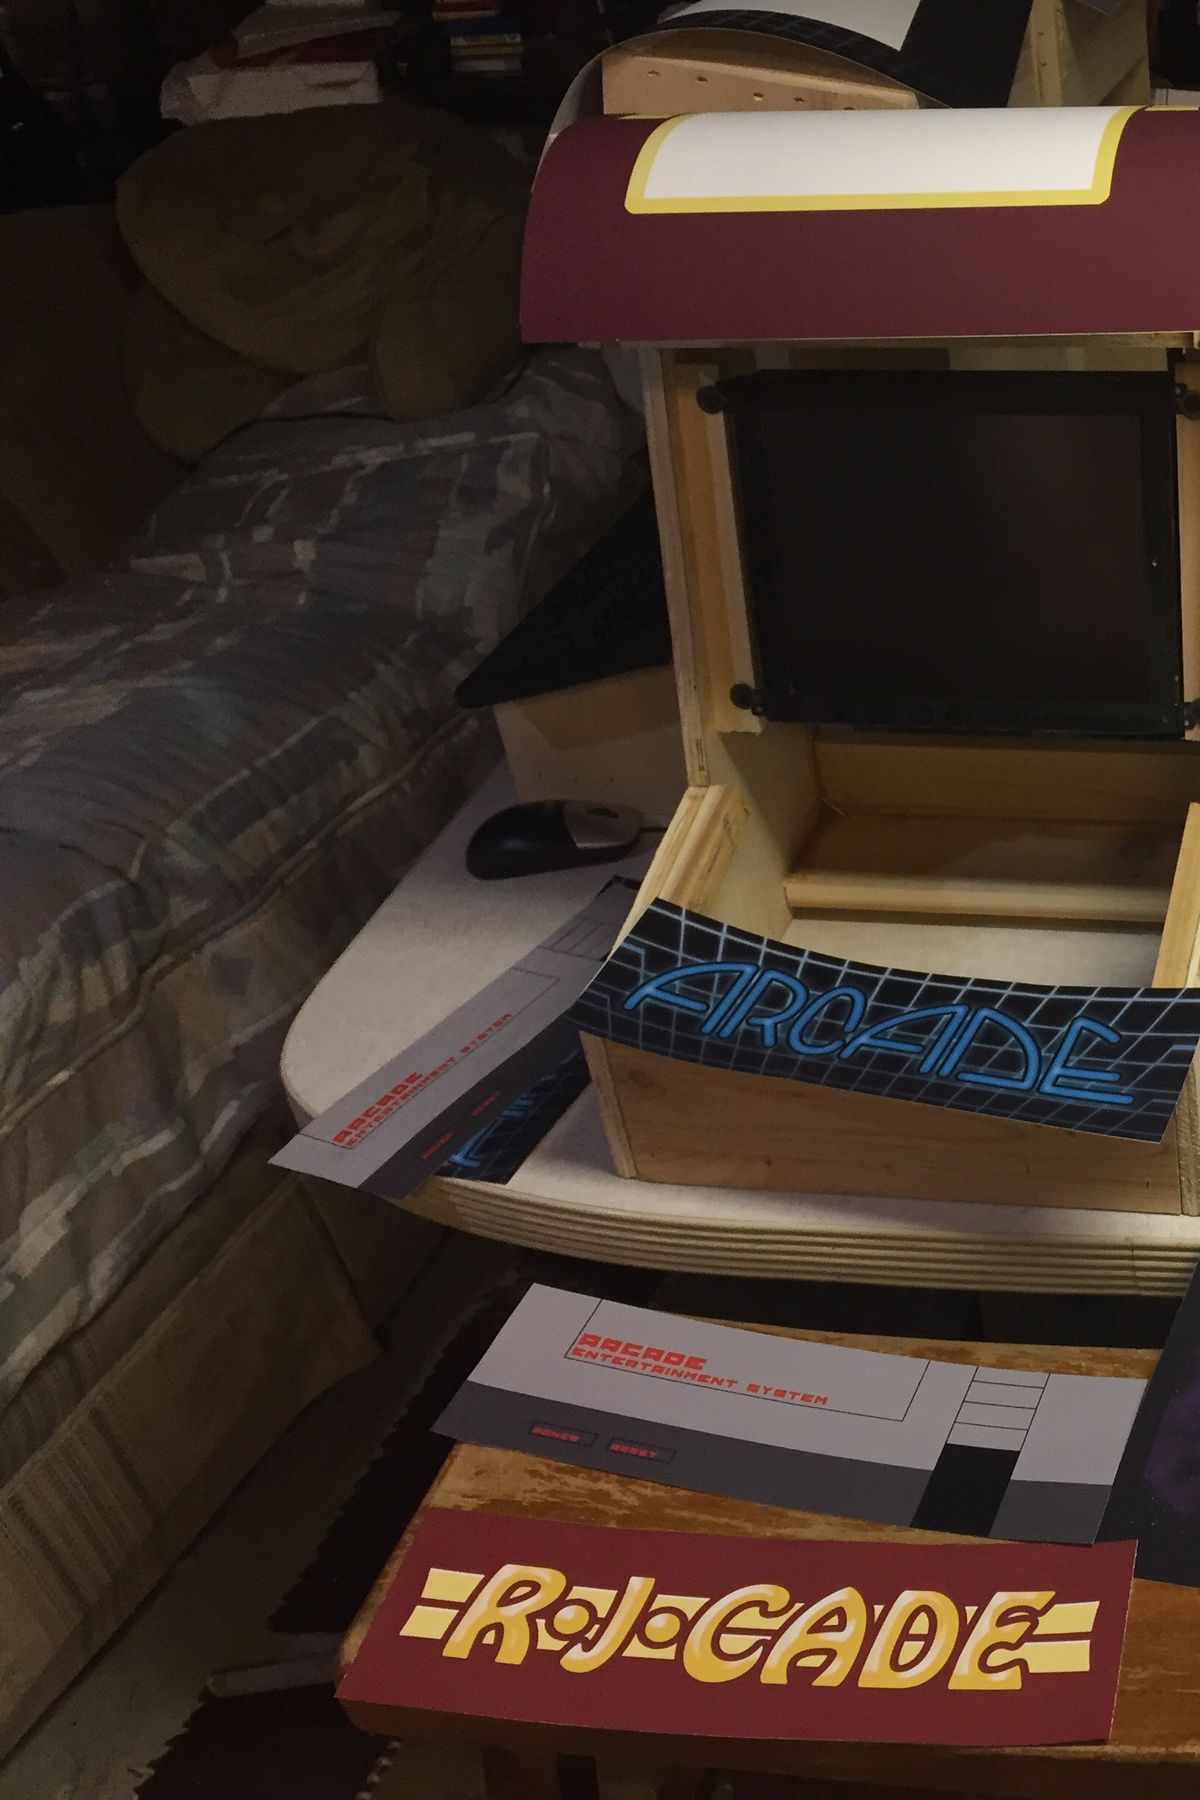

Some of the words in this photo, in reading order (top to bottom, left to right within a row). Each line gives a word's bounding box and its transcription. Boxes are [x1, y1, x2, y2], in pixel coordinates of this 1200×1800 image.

[625, 961, 1134, 1104] ARCADE
[570, 1347, 738, 1388] ENTERTAINMENT
[746, 1383, 828, 1405] SYSTEM
[578, 1332, 707, 1371] ARCADE
